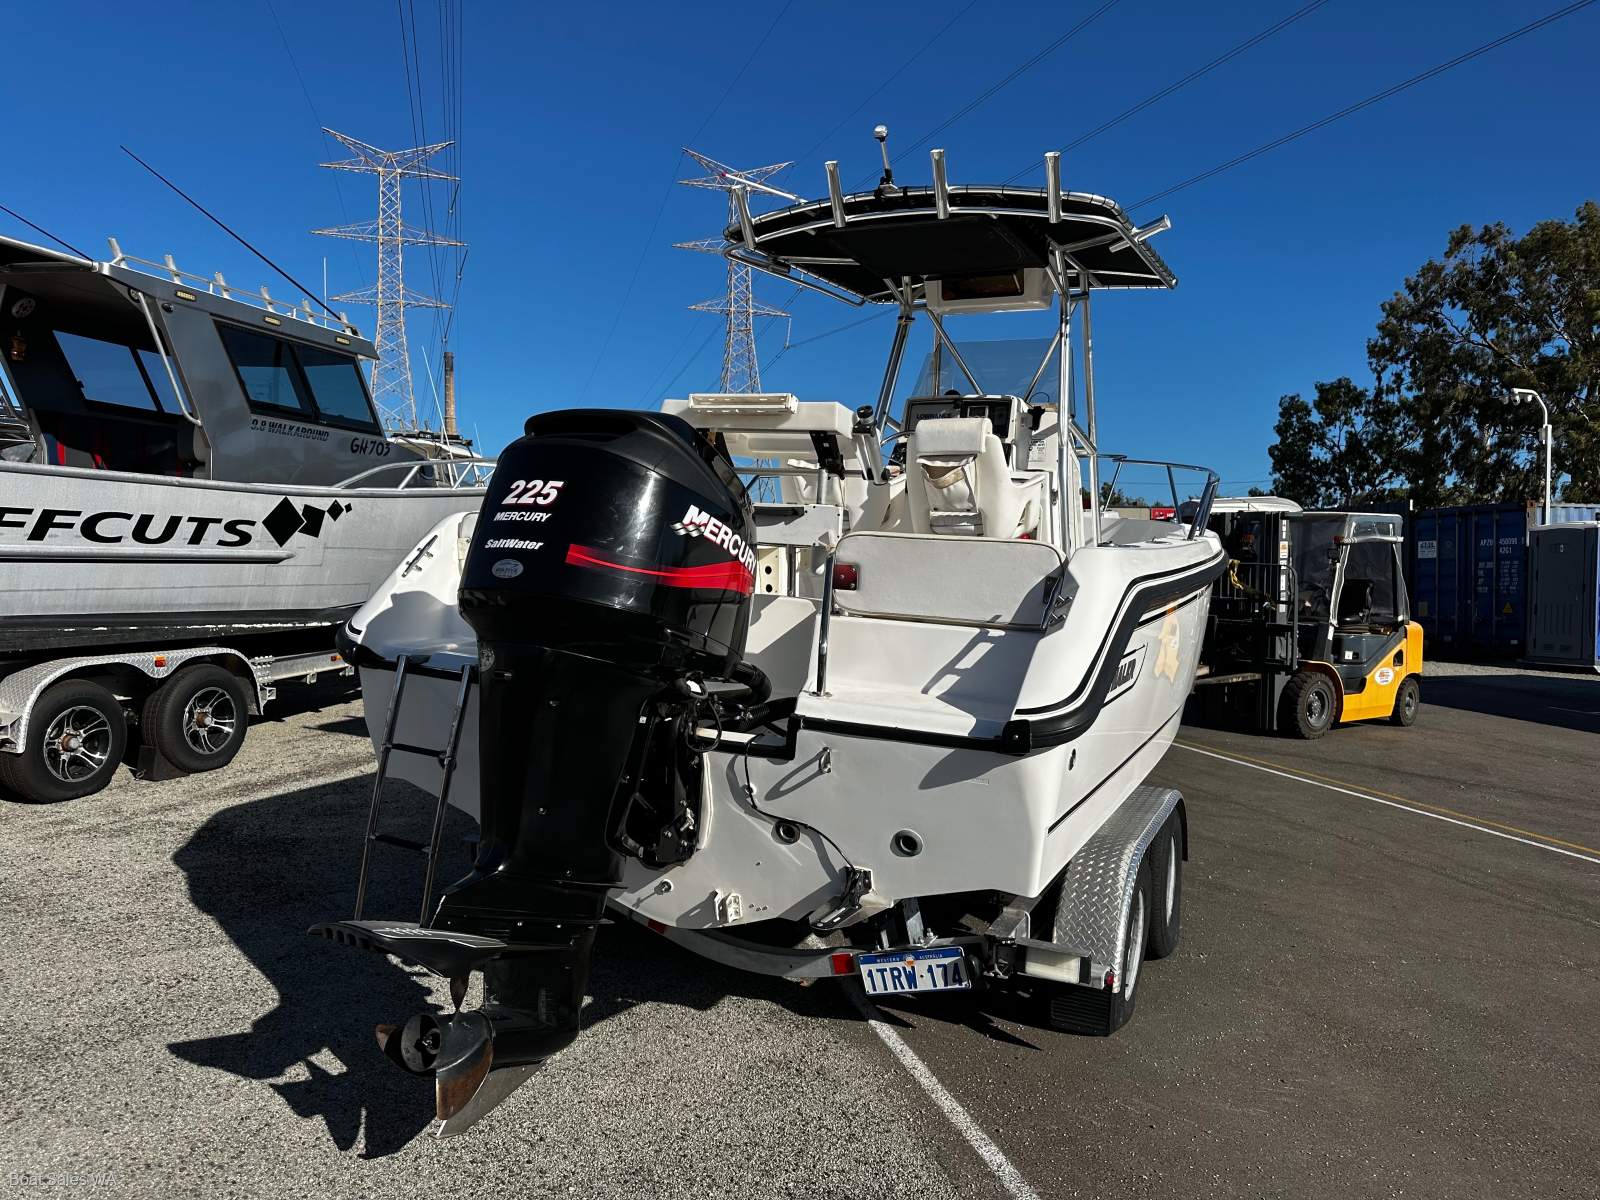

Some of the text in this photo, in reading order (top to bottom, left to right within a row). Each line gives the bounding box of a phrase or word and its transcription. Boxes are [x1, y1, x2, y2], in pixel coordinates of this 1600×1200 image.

[501, 479, 564, 505] 225
[493, 511, 552, 522] MERCURY
[484, 538, 544, 549] SaltWater
[681, 504, 757, 575] MERCURY
